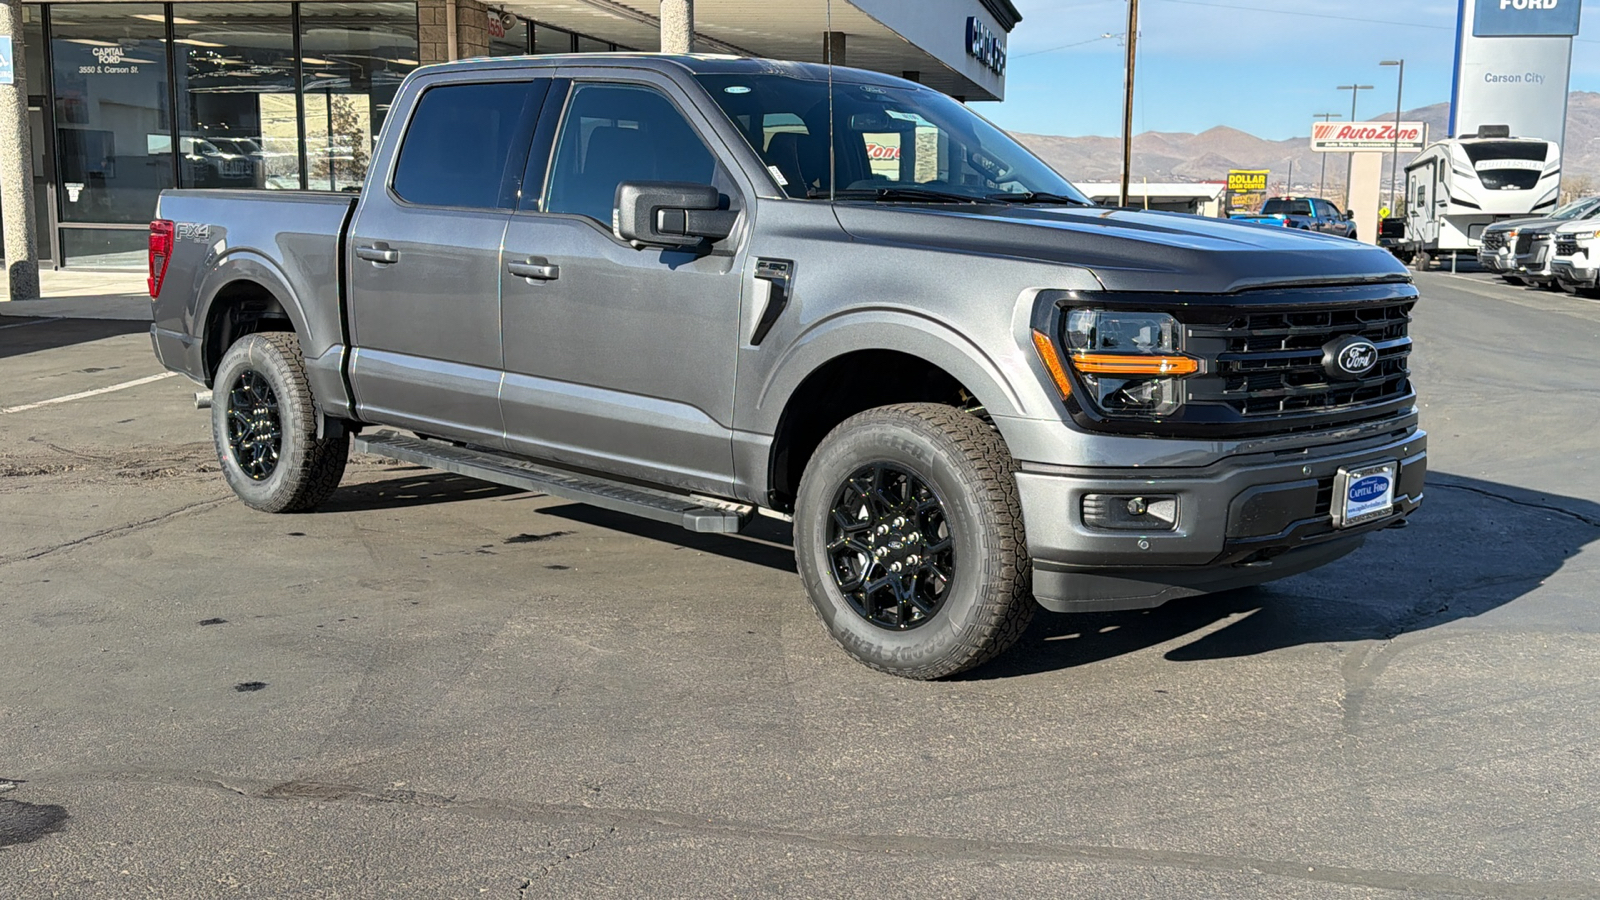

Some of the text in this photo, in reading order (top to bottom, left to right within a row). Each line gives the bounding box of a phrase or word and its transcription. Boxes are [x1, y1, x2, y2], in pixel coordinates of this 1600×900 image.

[1500, 0, 1558, 10] FORD
[487, 17, 506, 39] 550
[92, 47, 124, 56] CAPITAL
[98, 55, 121, 64] FORD
[78, 66, 139, 74] 3550 S. Carson St.
[1484, 73, 1546, 85] Carson City
[1336, 125, 1418, 140] AutoZone
[1228, 175, 1266, 184] DOLLAR
[175, 222, 210, 240] FX4
[1346, 347, 1371, 369] Ford
[1350, 486, 1373, 499] CAPITAL
[1373, 482, 1388, 493] FORD
